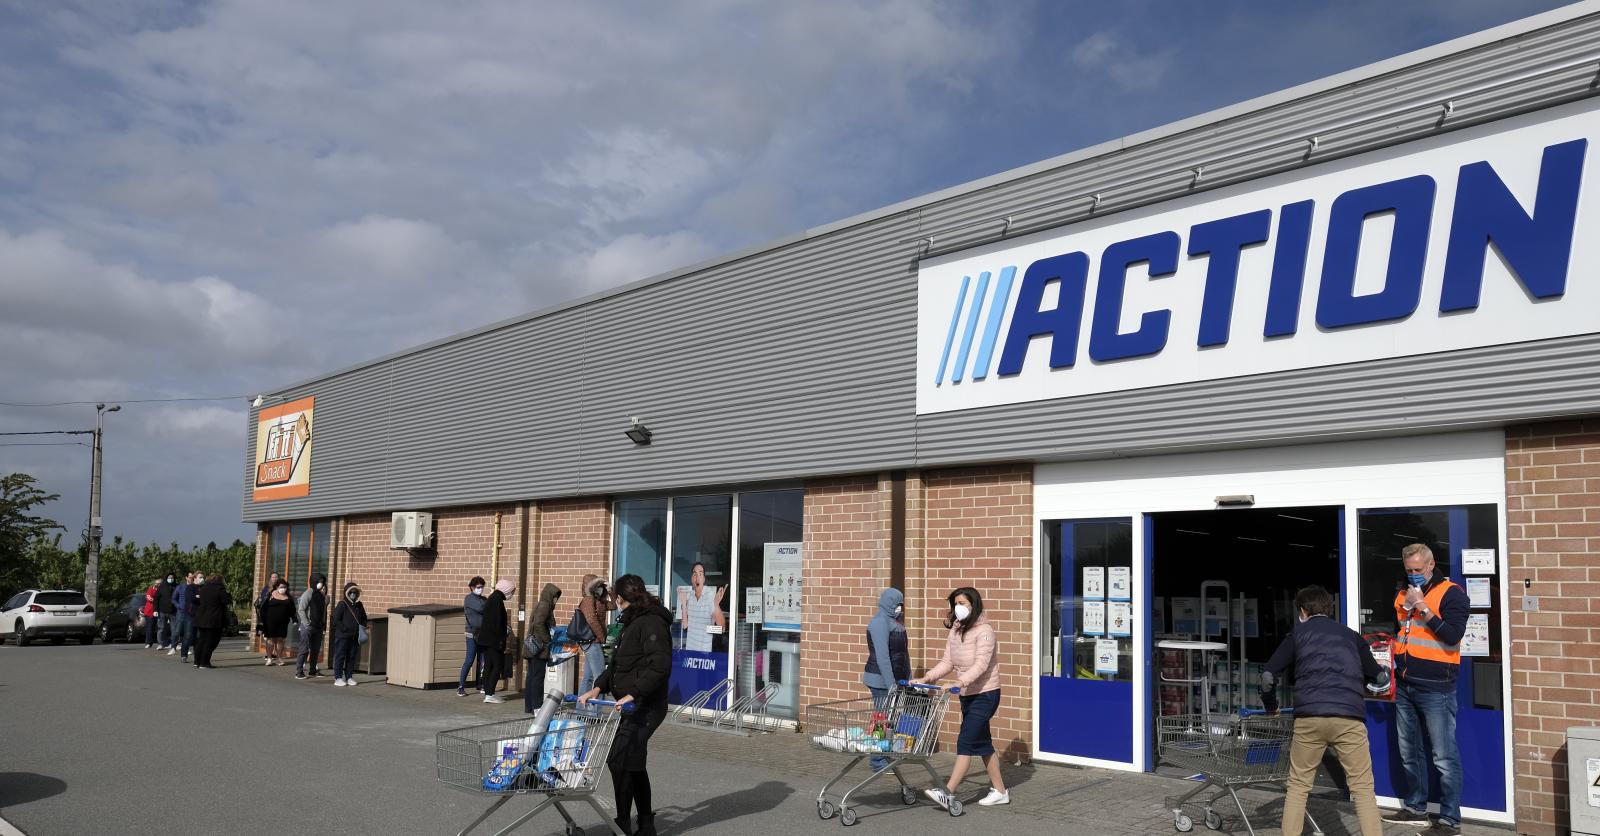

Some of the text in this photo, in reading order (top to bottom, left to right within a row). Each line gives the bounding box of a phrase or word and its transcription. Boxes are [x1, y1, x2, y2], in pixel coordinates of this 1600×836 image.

[997, 137, 1587, 376] ACTION
[261, 462, 286, 482] Snack
[686, 657, 716, 671] ACTION
